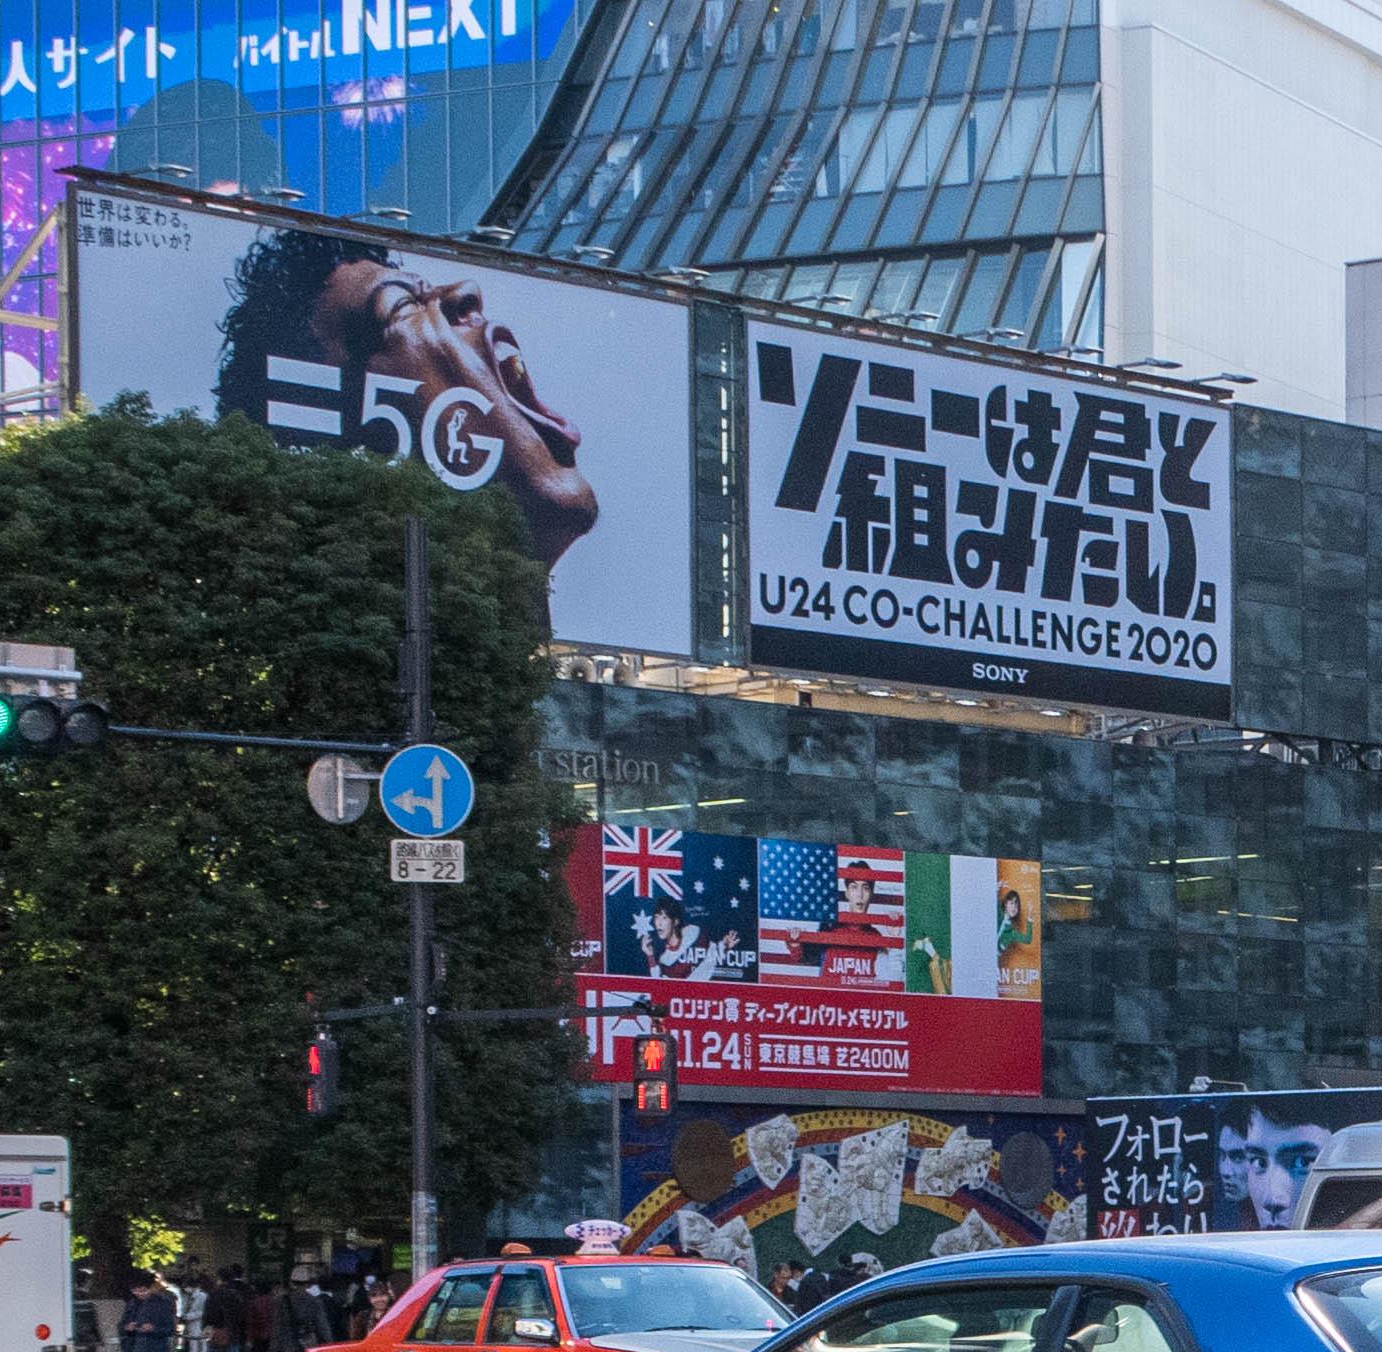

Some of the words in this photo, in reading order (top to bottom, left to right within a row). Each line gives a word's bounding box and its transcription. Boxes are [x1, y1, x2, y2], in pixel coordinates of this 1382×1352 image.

[77, 196, 188, 230] 世界は変わる。
[757, 341, 1216, 513] ソニーは君と
[822, 450, 1216, 623] 組みたい。
[759, 572, 834, 621] U24
[843, 584, 1120, 658] CO-CHALLENGE
[1128, 622, 1218, 671] 2020
[972, 661, 1029, 685] SONY
[555, 749, 660, 785] station
[678, 946, 726, 967] JAPN
[727, 949, 756, 968] CUP
[827, 957, 871, 976] JAPAN
[1014, 968, 1040, 985] CUP
[670, 997, 740, 1024] ロンジン賞
[745, 1001, 909, 1030] ディープインパクトメモリアル
[744, 1033, 752, 1071] SUN
[759, 1043, 830, 1067] 東京競馬場
[836, 1047, 909, 1071] 芝2400M
[1095, 1114, 1208, 1162] フォロー
[1101, 1163, 1204, 1205] されたら
